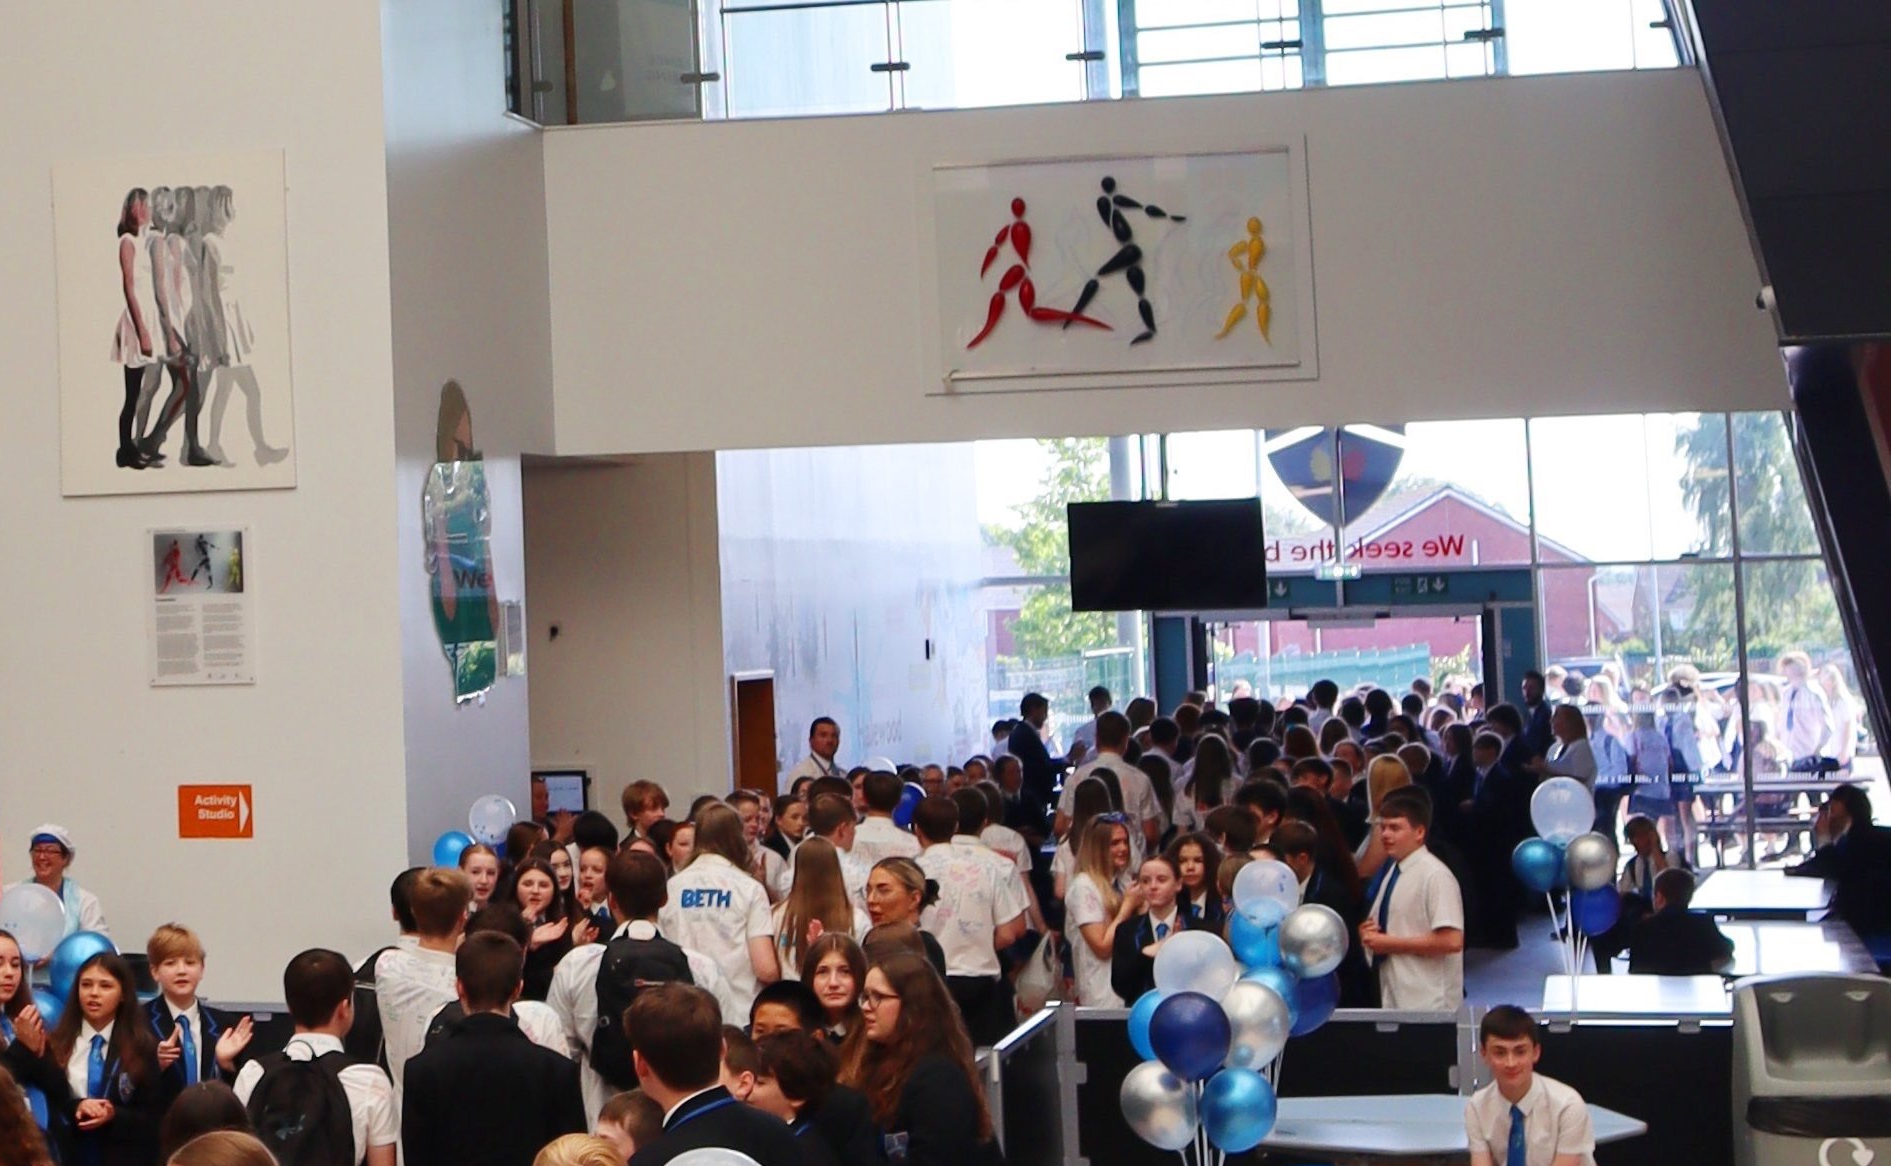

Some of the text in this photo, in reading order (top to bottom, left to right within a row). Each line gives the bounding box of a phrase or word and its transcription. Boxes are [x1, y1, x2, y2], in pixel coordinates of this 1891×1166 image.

[194, 794, 238, 808] Activity
[198, 808, 236, 820] Studio
[681, 889, 731, 908] BETH
